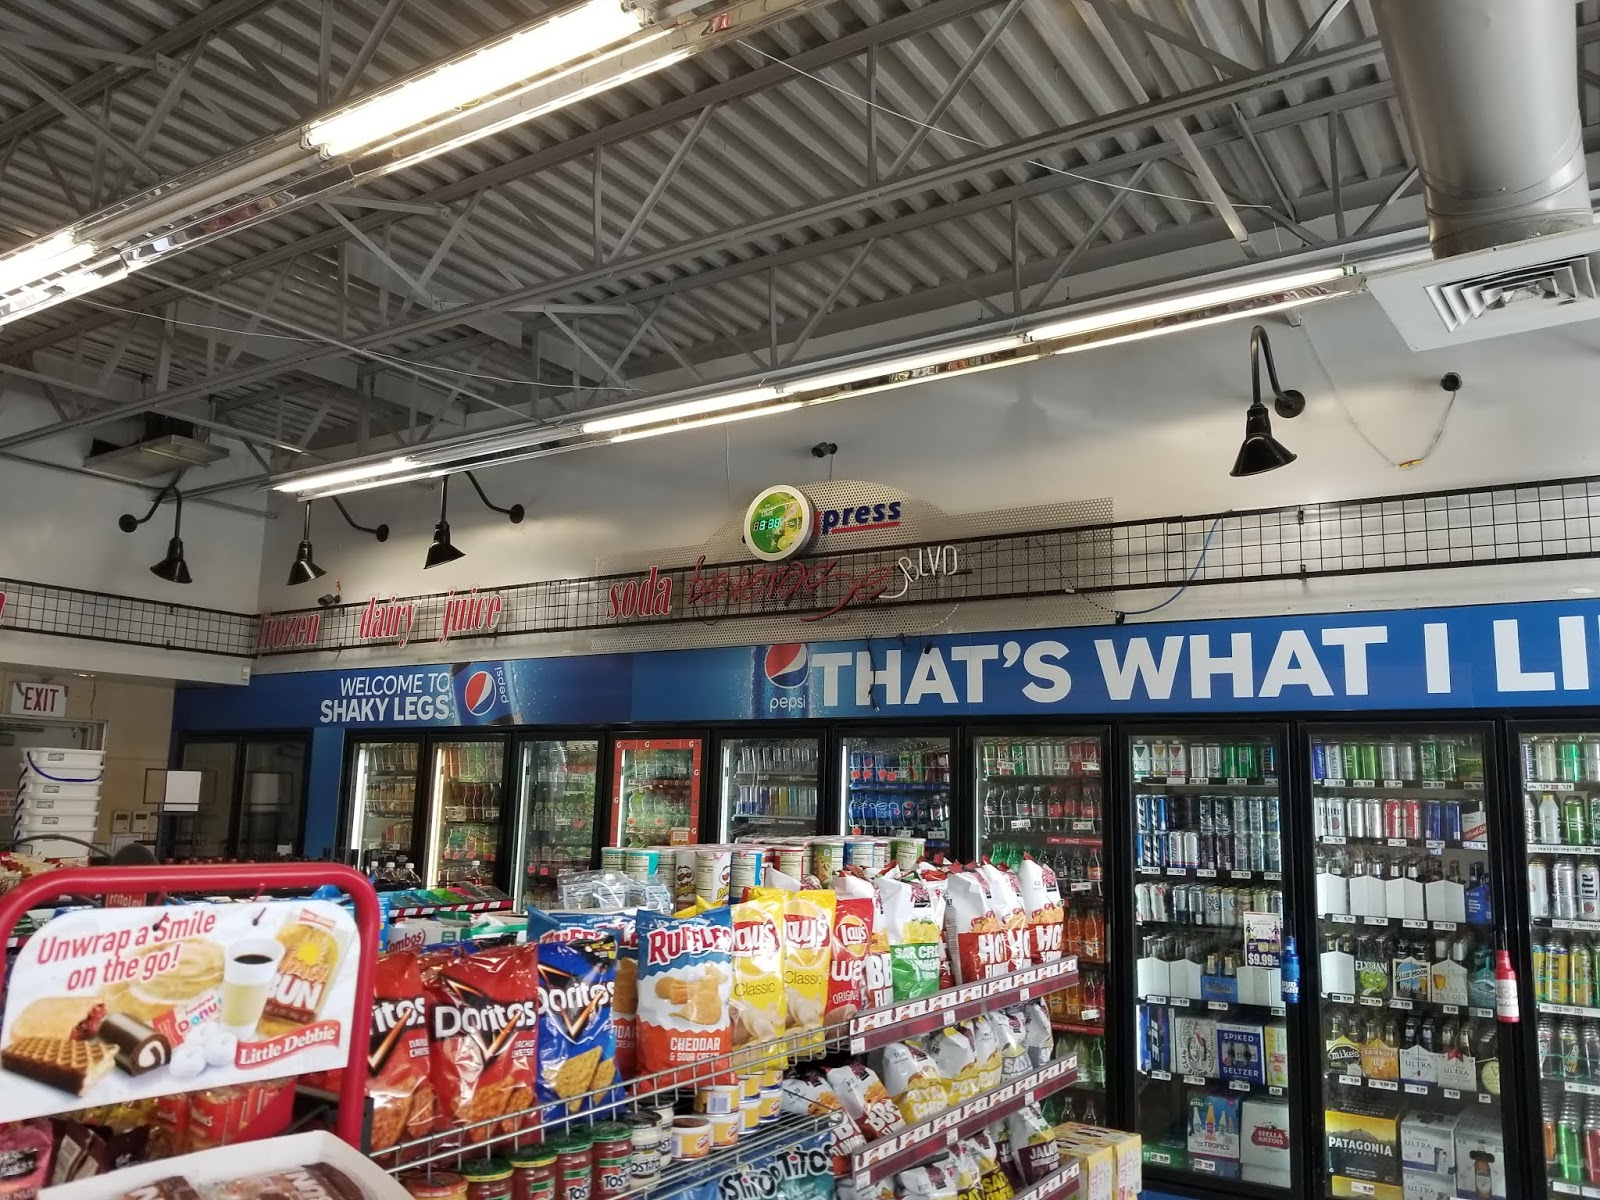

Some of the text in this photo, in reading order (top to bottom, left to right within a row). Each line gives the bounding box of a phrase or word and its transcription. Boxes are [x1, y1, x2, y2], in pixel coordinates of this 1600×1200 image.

[606, 566, 673, 619] soda
[687, 545, 957, 622] beverage BLVD
[359, 596, 417, 648] dairy
[438, 586, 502, 645] juice
[256, 611, 320, 649] frozen
[811, 615, 1600, 703] THAT'S WHAT I LI
[340, 672, 450, 697] WELCOME TO
[500, 667, 508, 704] pepsi
[23, 687, 60, 712] EXIT
[319, 694, 450, 723] SHAKY LEGS
[769, 695, 806, 711] pepsi
[37, 910, 217, 965] Unwrap a Smile
[650, 926, 732, 963] RUFFLES
[842, 923, 867, 945] Lay's
[67, 944, 180, 990] on the go!
[1355, 960, 1389, 974] ELYSIAN
[1394, 969, 1428, 981] BLUE MOON
[734, 982, 776, 997] Classic
[435, 1001, 537, 1038] Doritos
[239, 1025, 336, 1066] Little Debbie
[670, 1037, 720, 1051] CHEDDAR
[1223, 1032, 1254, 1042] SPIKED
[677, 1053, 695, 1062] SOUR
[1331, 1050, 1360, 1060] mike's
[1405, 1060, 1432, 1069] ULTRA
[1223, 1066, 1259, 1077] SELTZER
[1443, 1067, 1469, 1076] ULTRA
[1258, 1130, 1283, 1139] STELLA
[1258, 1137, 1284, 1146] ARTOIS
[1404, 1139, 1433, 1150] ULTRA
[1328, 1135, 1393, 1158] PATAGONIA
[1407, 1184, 1435, 1195] ULTRA
